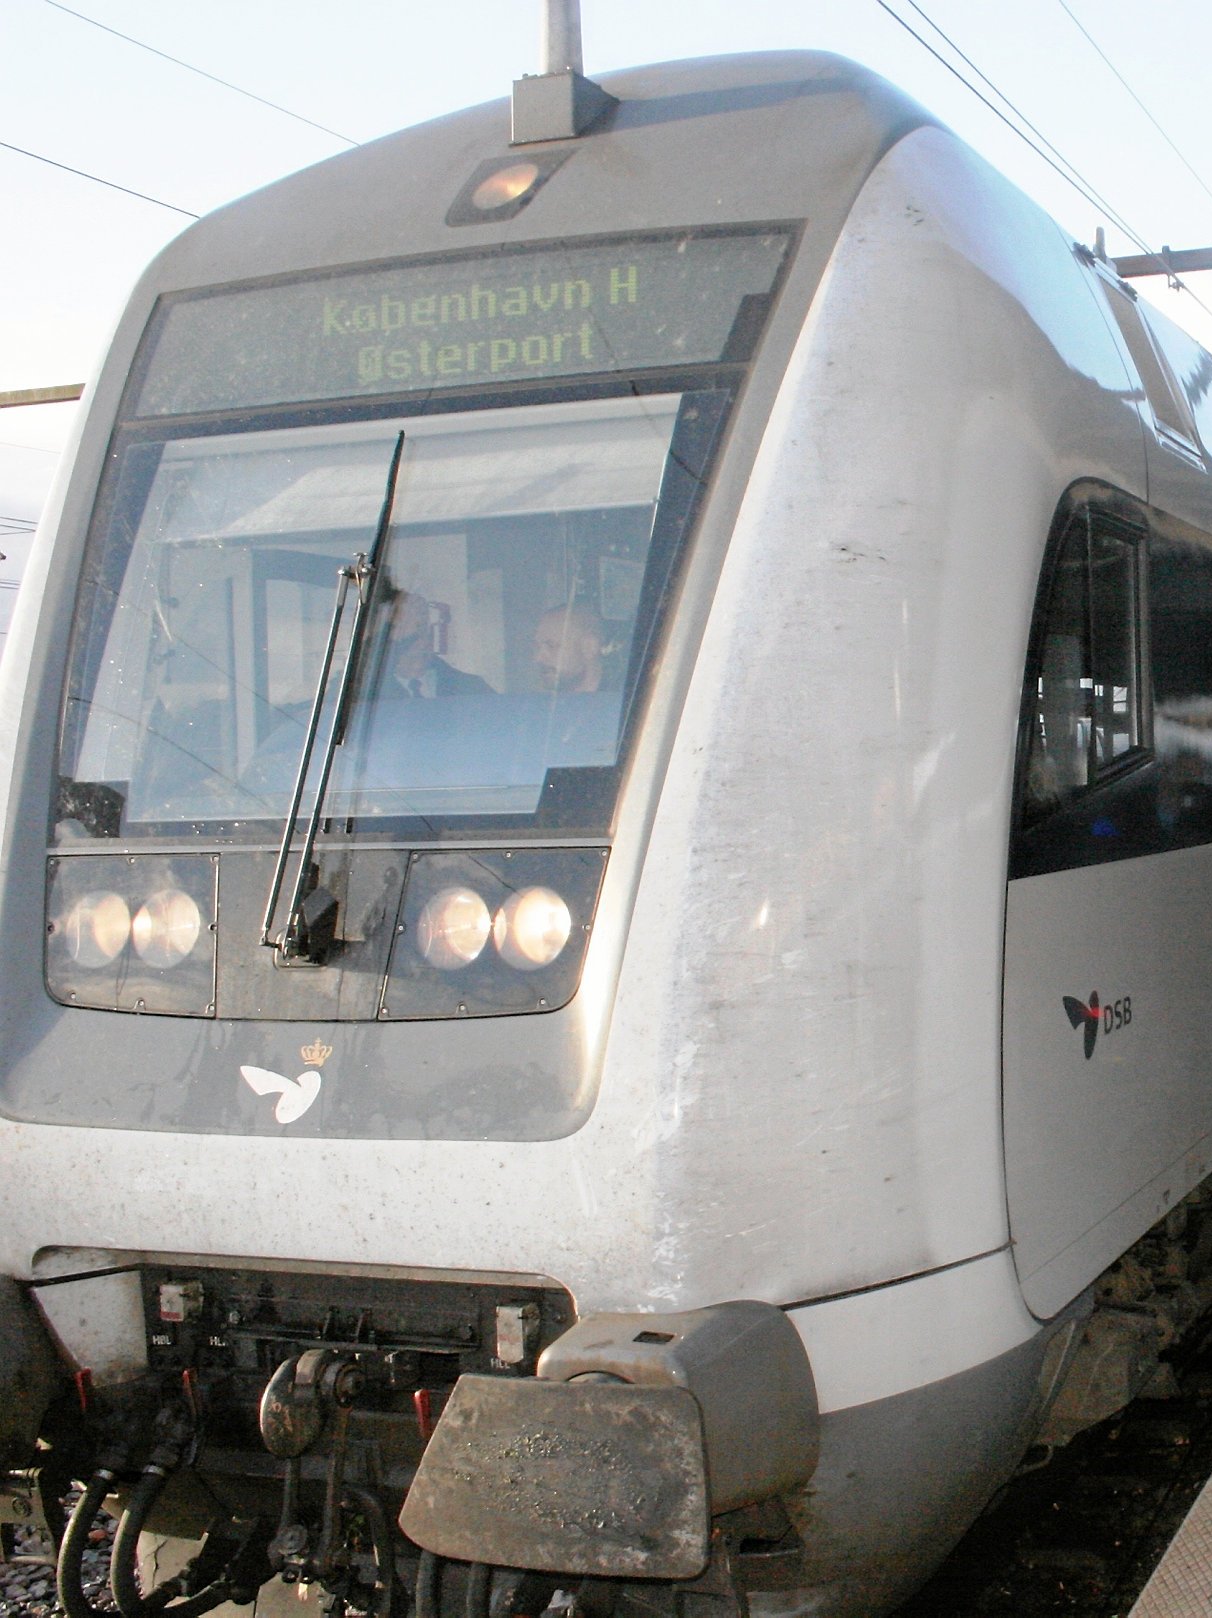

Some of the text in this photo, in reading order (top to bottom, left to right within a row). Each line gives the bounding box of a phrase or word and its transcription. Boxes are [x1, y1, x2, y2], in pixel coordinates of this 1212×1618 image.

[323, 265, 638, 335] København H
[357, 320, 594, 386] Østerport
[1103, 996, 1132, 1034] DSB
